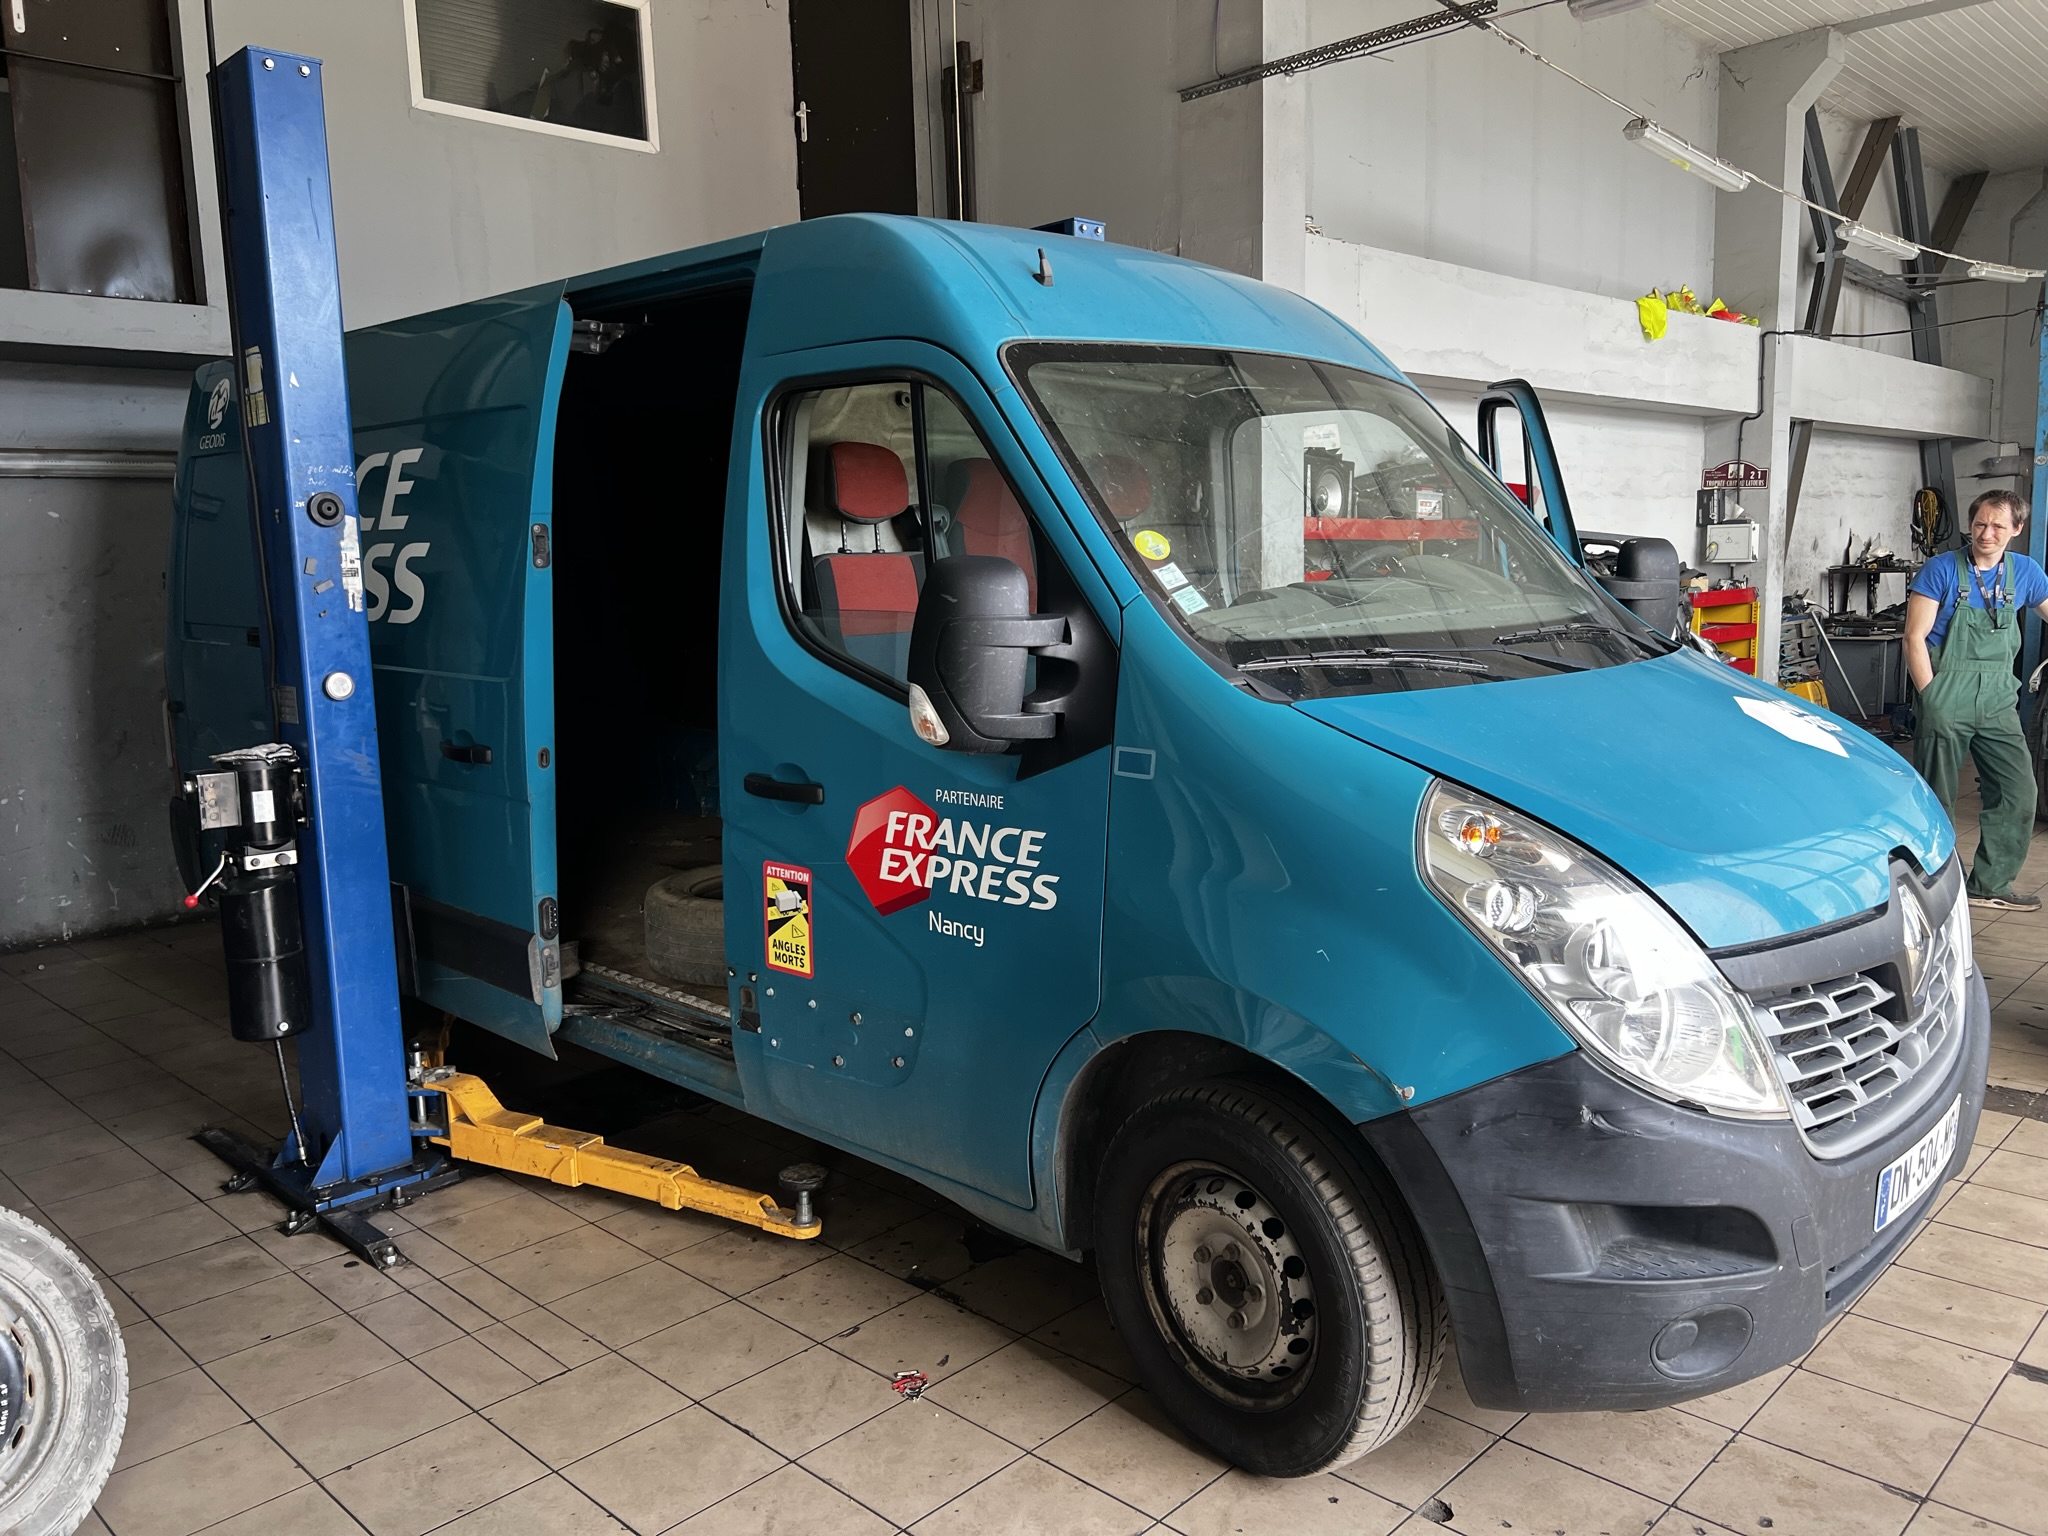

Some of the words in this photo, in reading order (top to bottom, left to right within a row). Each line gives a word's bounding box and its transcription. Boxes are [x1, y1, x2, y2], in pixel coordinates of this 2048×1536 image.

[200, 433, 226, 449] GEODIS
[935, 789, 1004, 810] PARTENAIRE
[885, 811, 1047, 868] FRANCE
[766, 866, 810, 882] ATTENTION
[879, 847, 1061, 911] EXPRESS
[929, 911, 985, 947] Nancy
[772, 939, 806, 956] ANGLES
[774, 951, 805, 968] MORTS
